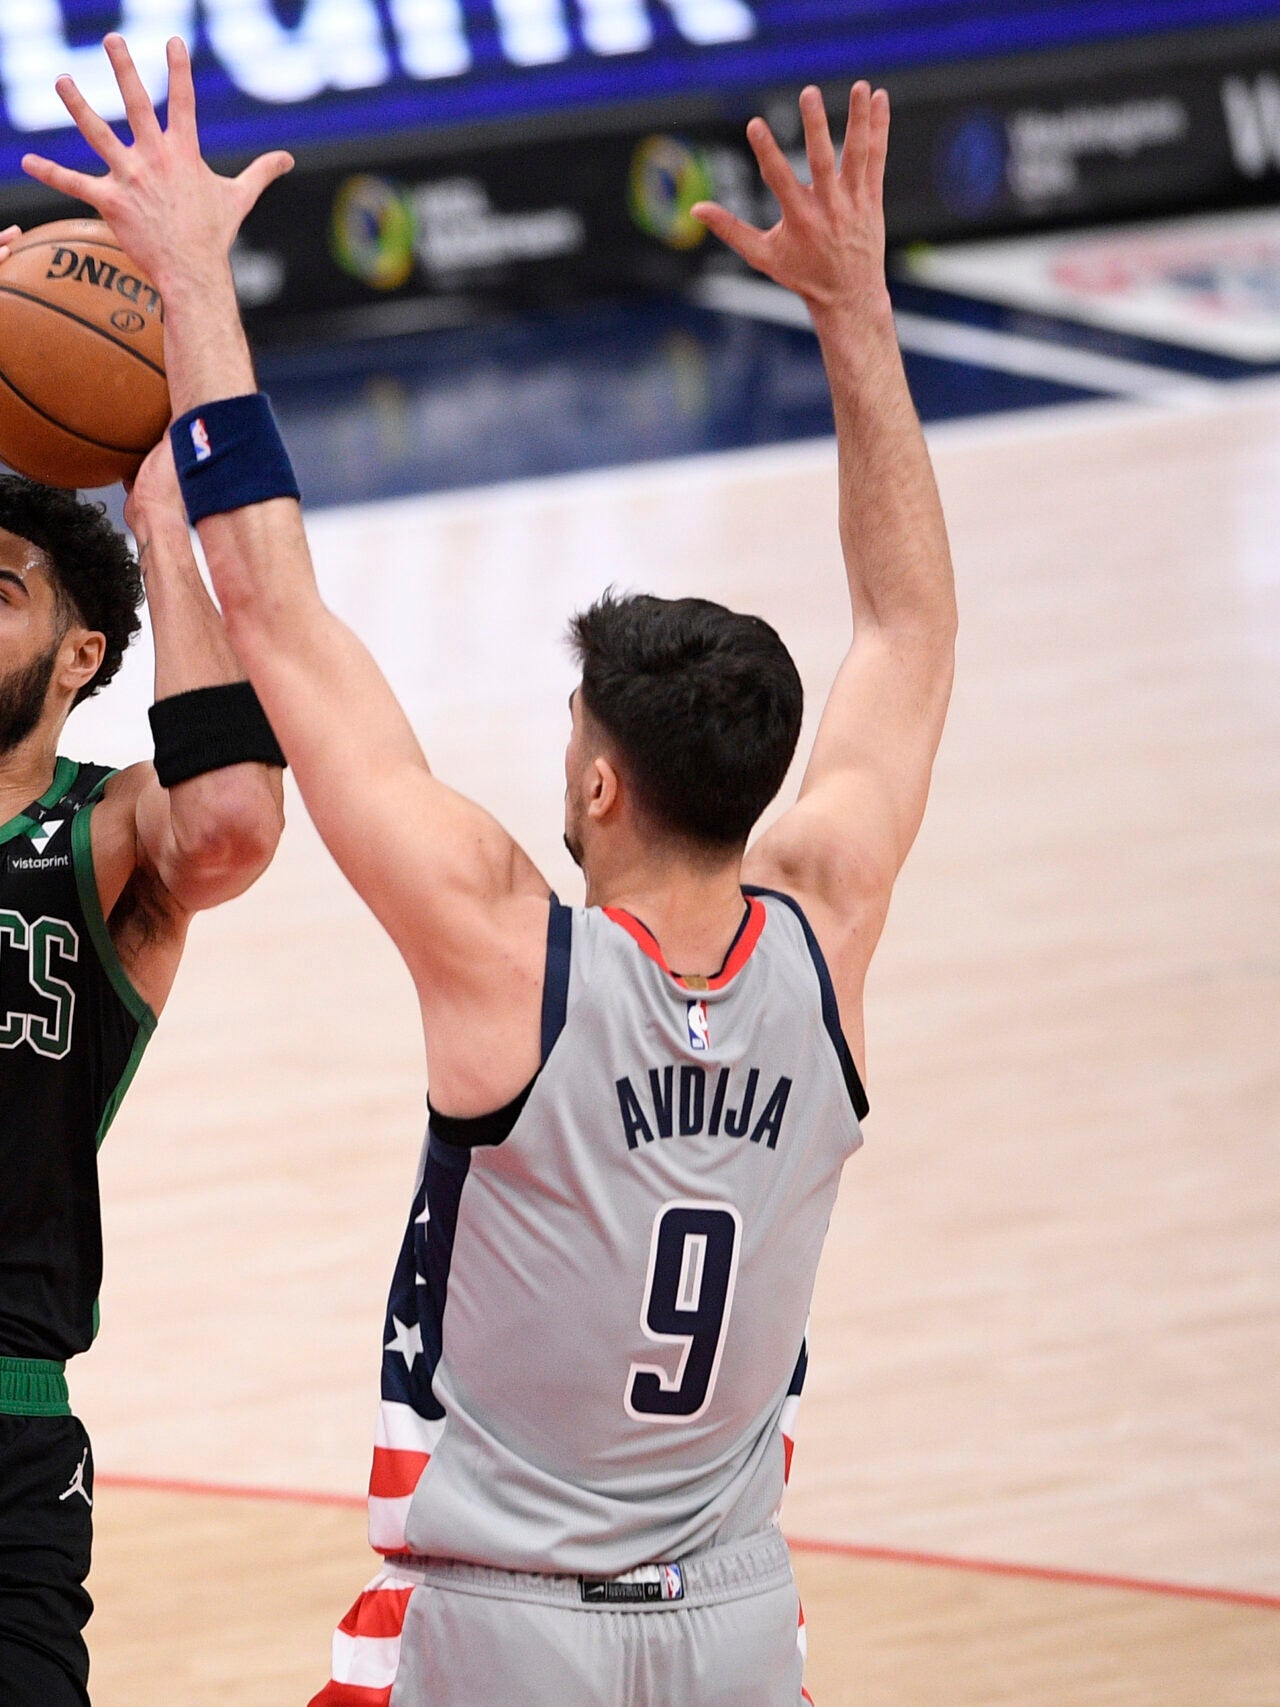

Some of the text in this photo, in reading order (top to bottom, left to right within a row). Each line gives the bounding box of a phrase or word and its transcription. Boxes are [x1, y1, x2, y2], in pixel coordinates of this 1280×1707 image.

[46, 246, 161, 314] LDING
[12, 855, 69, 870] vistaprint
[615, 1065, 793, 1150] AVDIJA
[623, 1199, 743, 1424] 9
